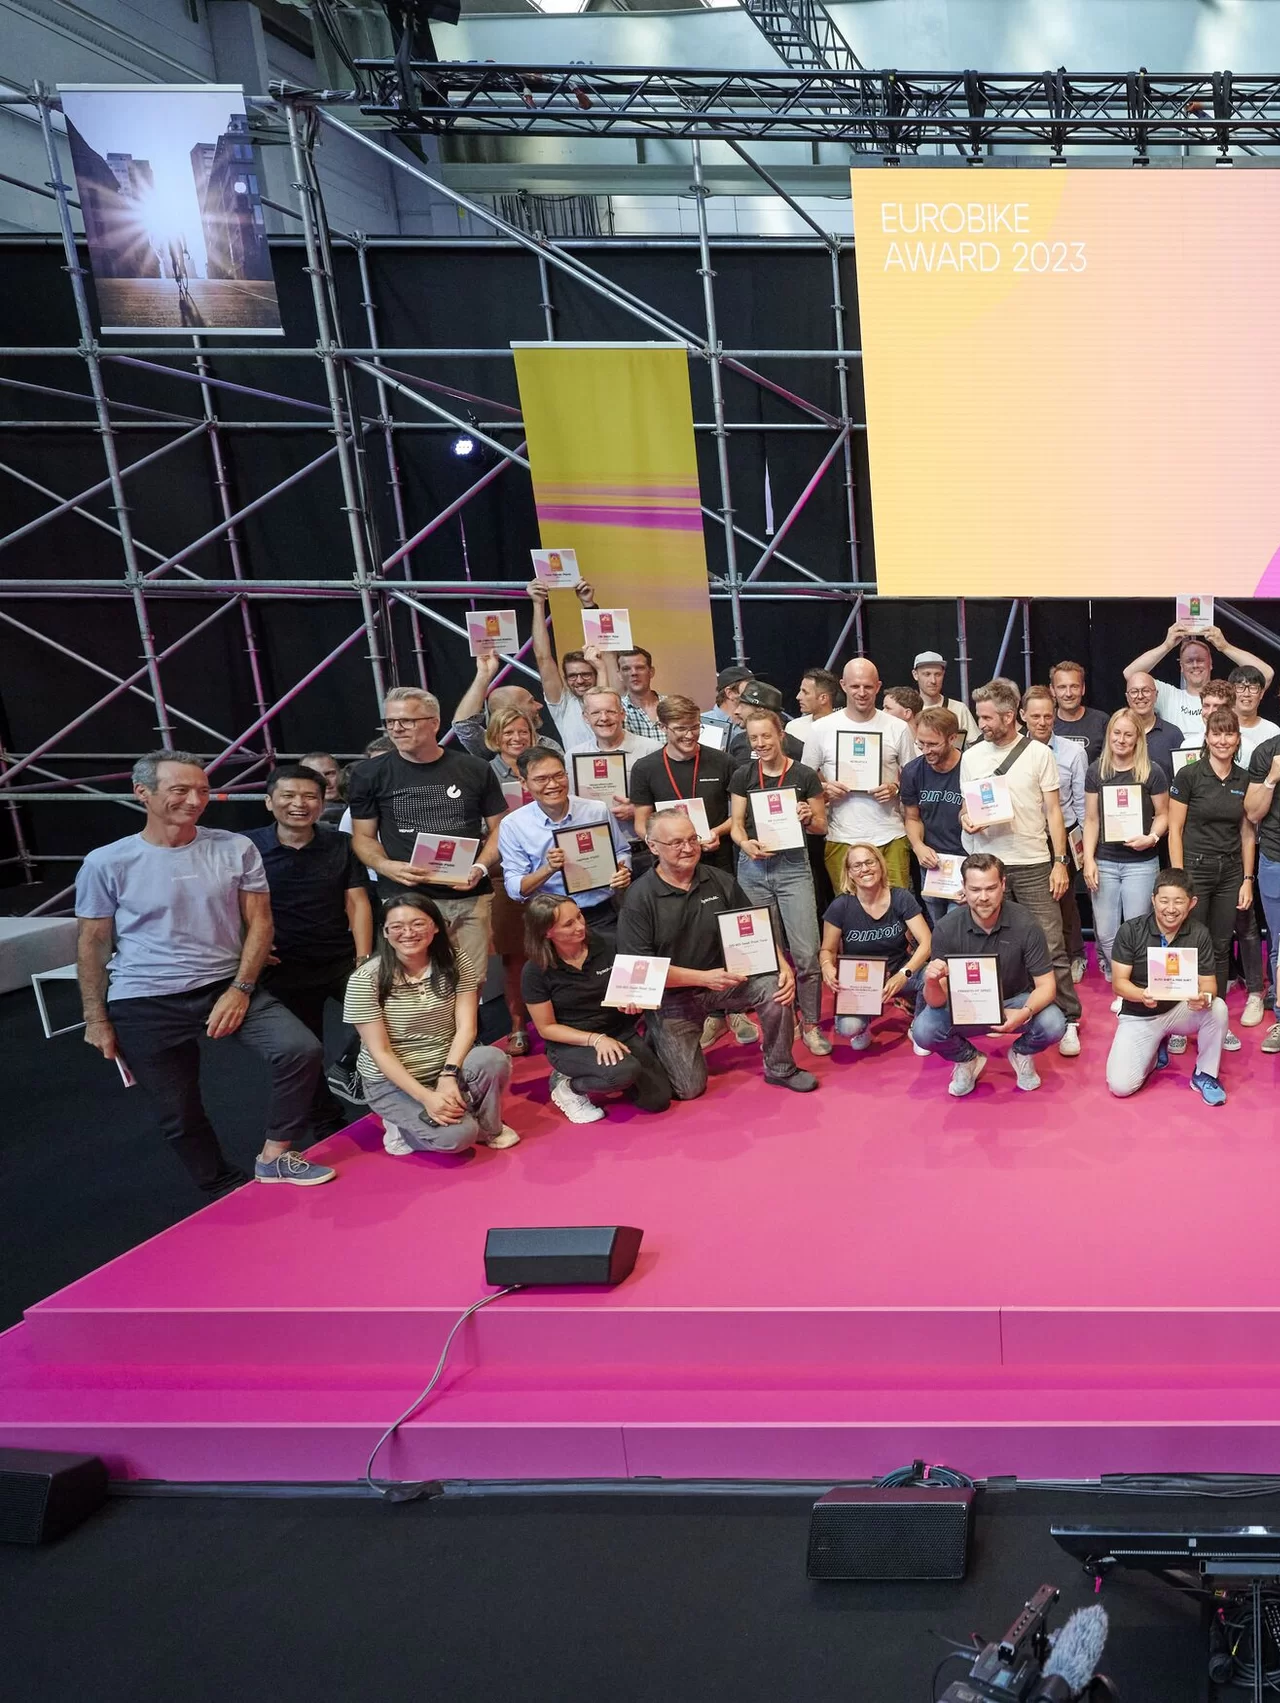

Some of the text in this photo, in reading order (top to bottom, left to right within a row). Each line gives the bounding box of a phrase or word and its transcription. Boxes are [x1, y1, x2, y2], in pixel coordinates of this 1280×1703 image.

[881, 203, 1030, 233] EUROBIKE
[884, 241, 1087, 272] AWARD 2023
[846, 920, 902, 942] pinion
